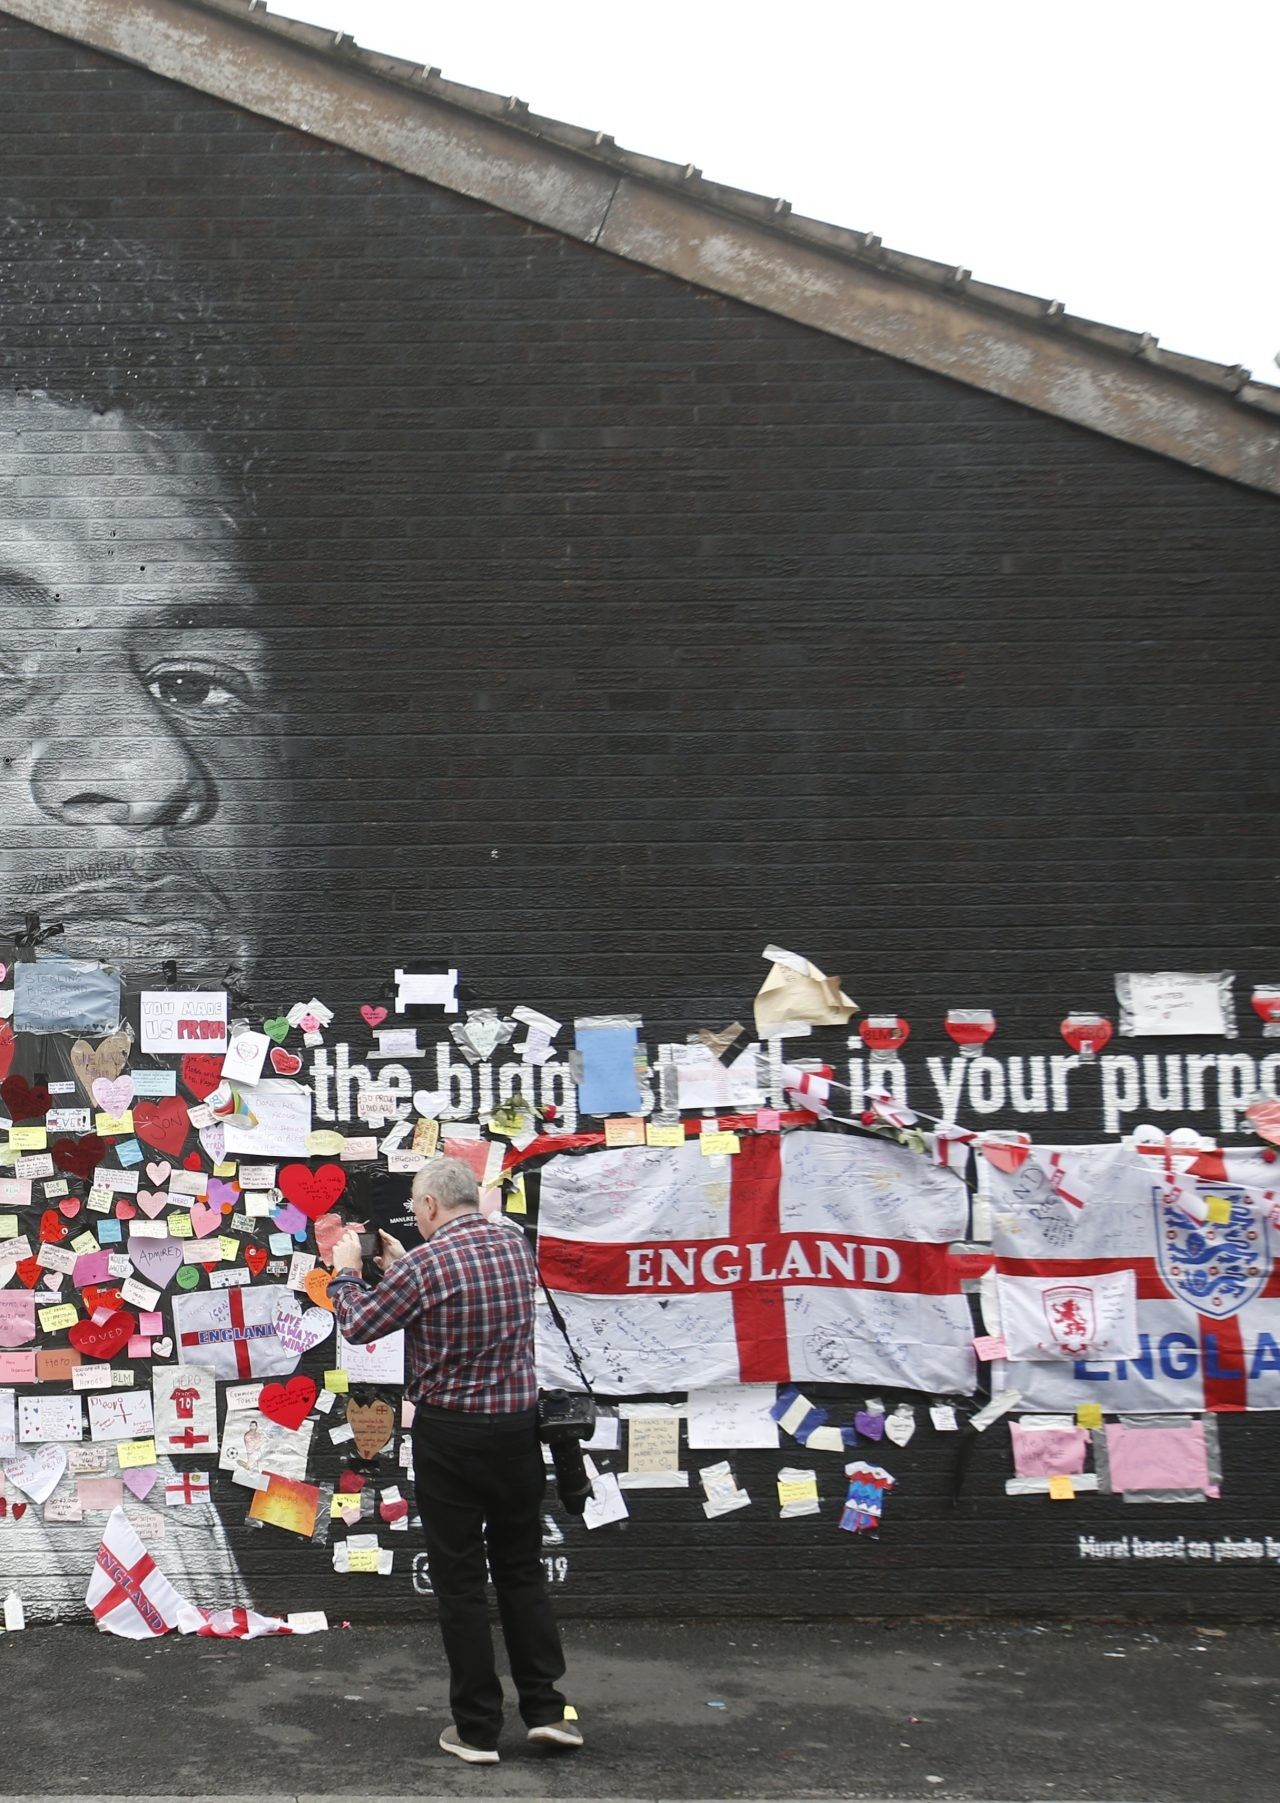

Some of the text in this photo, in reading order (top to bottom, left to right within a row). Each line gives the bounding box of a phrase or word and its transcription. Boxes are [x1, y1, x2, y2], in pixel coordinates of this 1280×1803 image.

[143, 1001, 222, 1015] YOU MADE
[145, 1020, 174, 1041] US
[309, 1042, 413, 1123] the
[847, 1036, 907, 1114] in
[926, 1053, 1079, 1132] your
[139, 1245, 182, 1266] ADMIRED
[626, 1238, 902, 1288] ENGLAND
[277, 1311, 303, 1329] LOVE
[79, 1327, 123, 1345] LOVED
[45, 1358, 70, 1368] Hero
[113, 1373, 132, 1383] BLM
[1132, 1535, 1187, 1559] based
[1213, 1535, 1266, 1563] photo
[539, 1555, 569, 1583] 19
